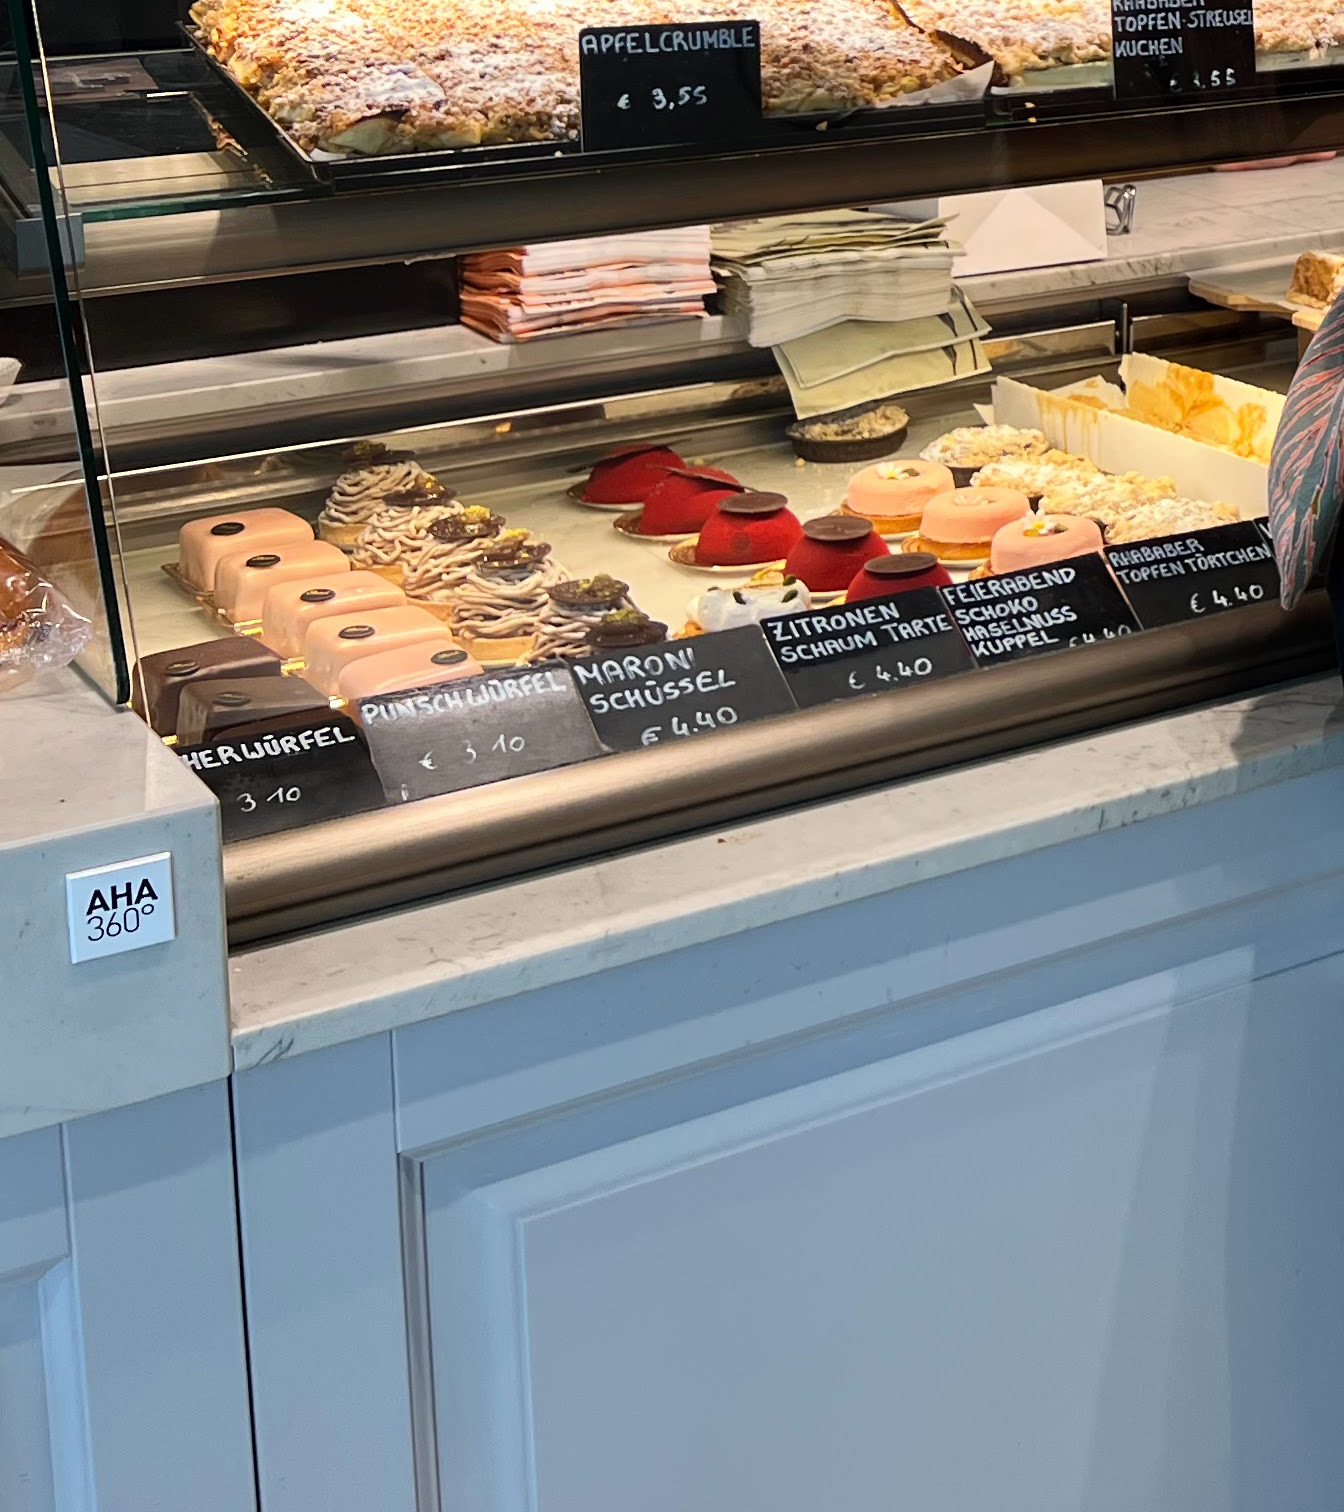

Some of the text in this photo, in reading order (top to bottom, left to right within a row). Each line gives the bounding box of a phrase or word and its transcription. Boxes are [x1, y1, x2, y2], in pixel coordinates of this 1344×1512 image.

[582, 27, 755, 55] APFELCRUMBLE
[1115, 37, 1183, 57] KUCHEN
[617, 86, 707, 110] € 3,55
[1109, 537, 1205, 567] RHABABER
[1116, 542, 1270, 585] TOPFEN TÖRTCHEN
[942, 567, 1077, 606] FEIERABEND
[1191, 584, 1264, 612] € 4.40
[768, 602, 899, 642] ZITRONEN
[955, 596, 1038, 625] SCHOKO
[964, 605, 1077, 643] HASELNUSS
[781, 614, 952, 663] SCHAUM TARTE
[971, 631, 1059, 658] KUPPEL
[573, 647, 696, 685] MARONI
[849, 657, 932, 689] € 4.40
[590, 669, 736, 713] SCHÜSSEL
[671, 706, 737, 736] 4.40
[179, 727, 355, 772] HERWÜRFEL
[86, 878, 158, 916] AHA
[87, 904, 154, 941] 360°
